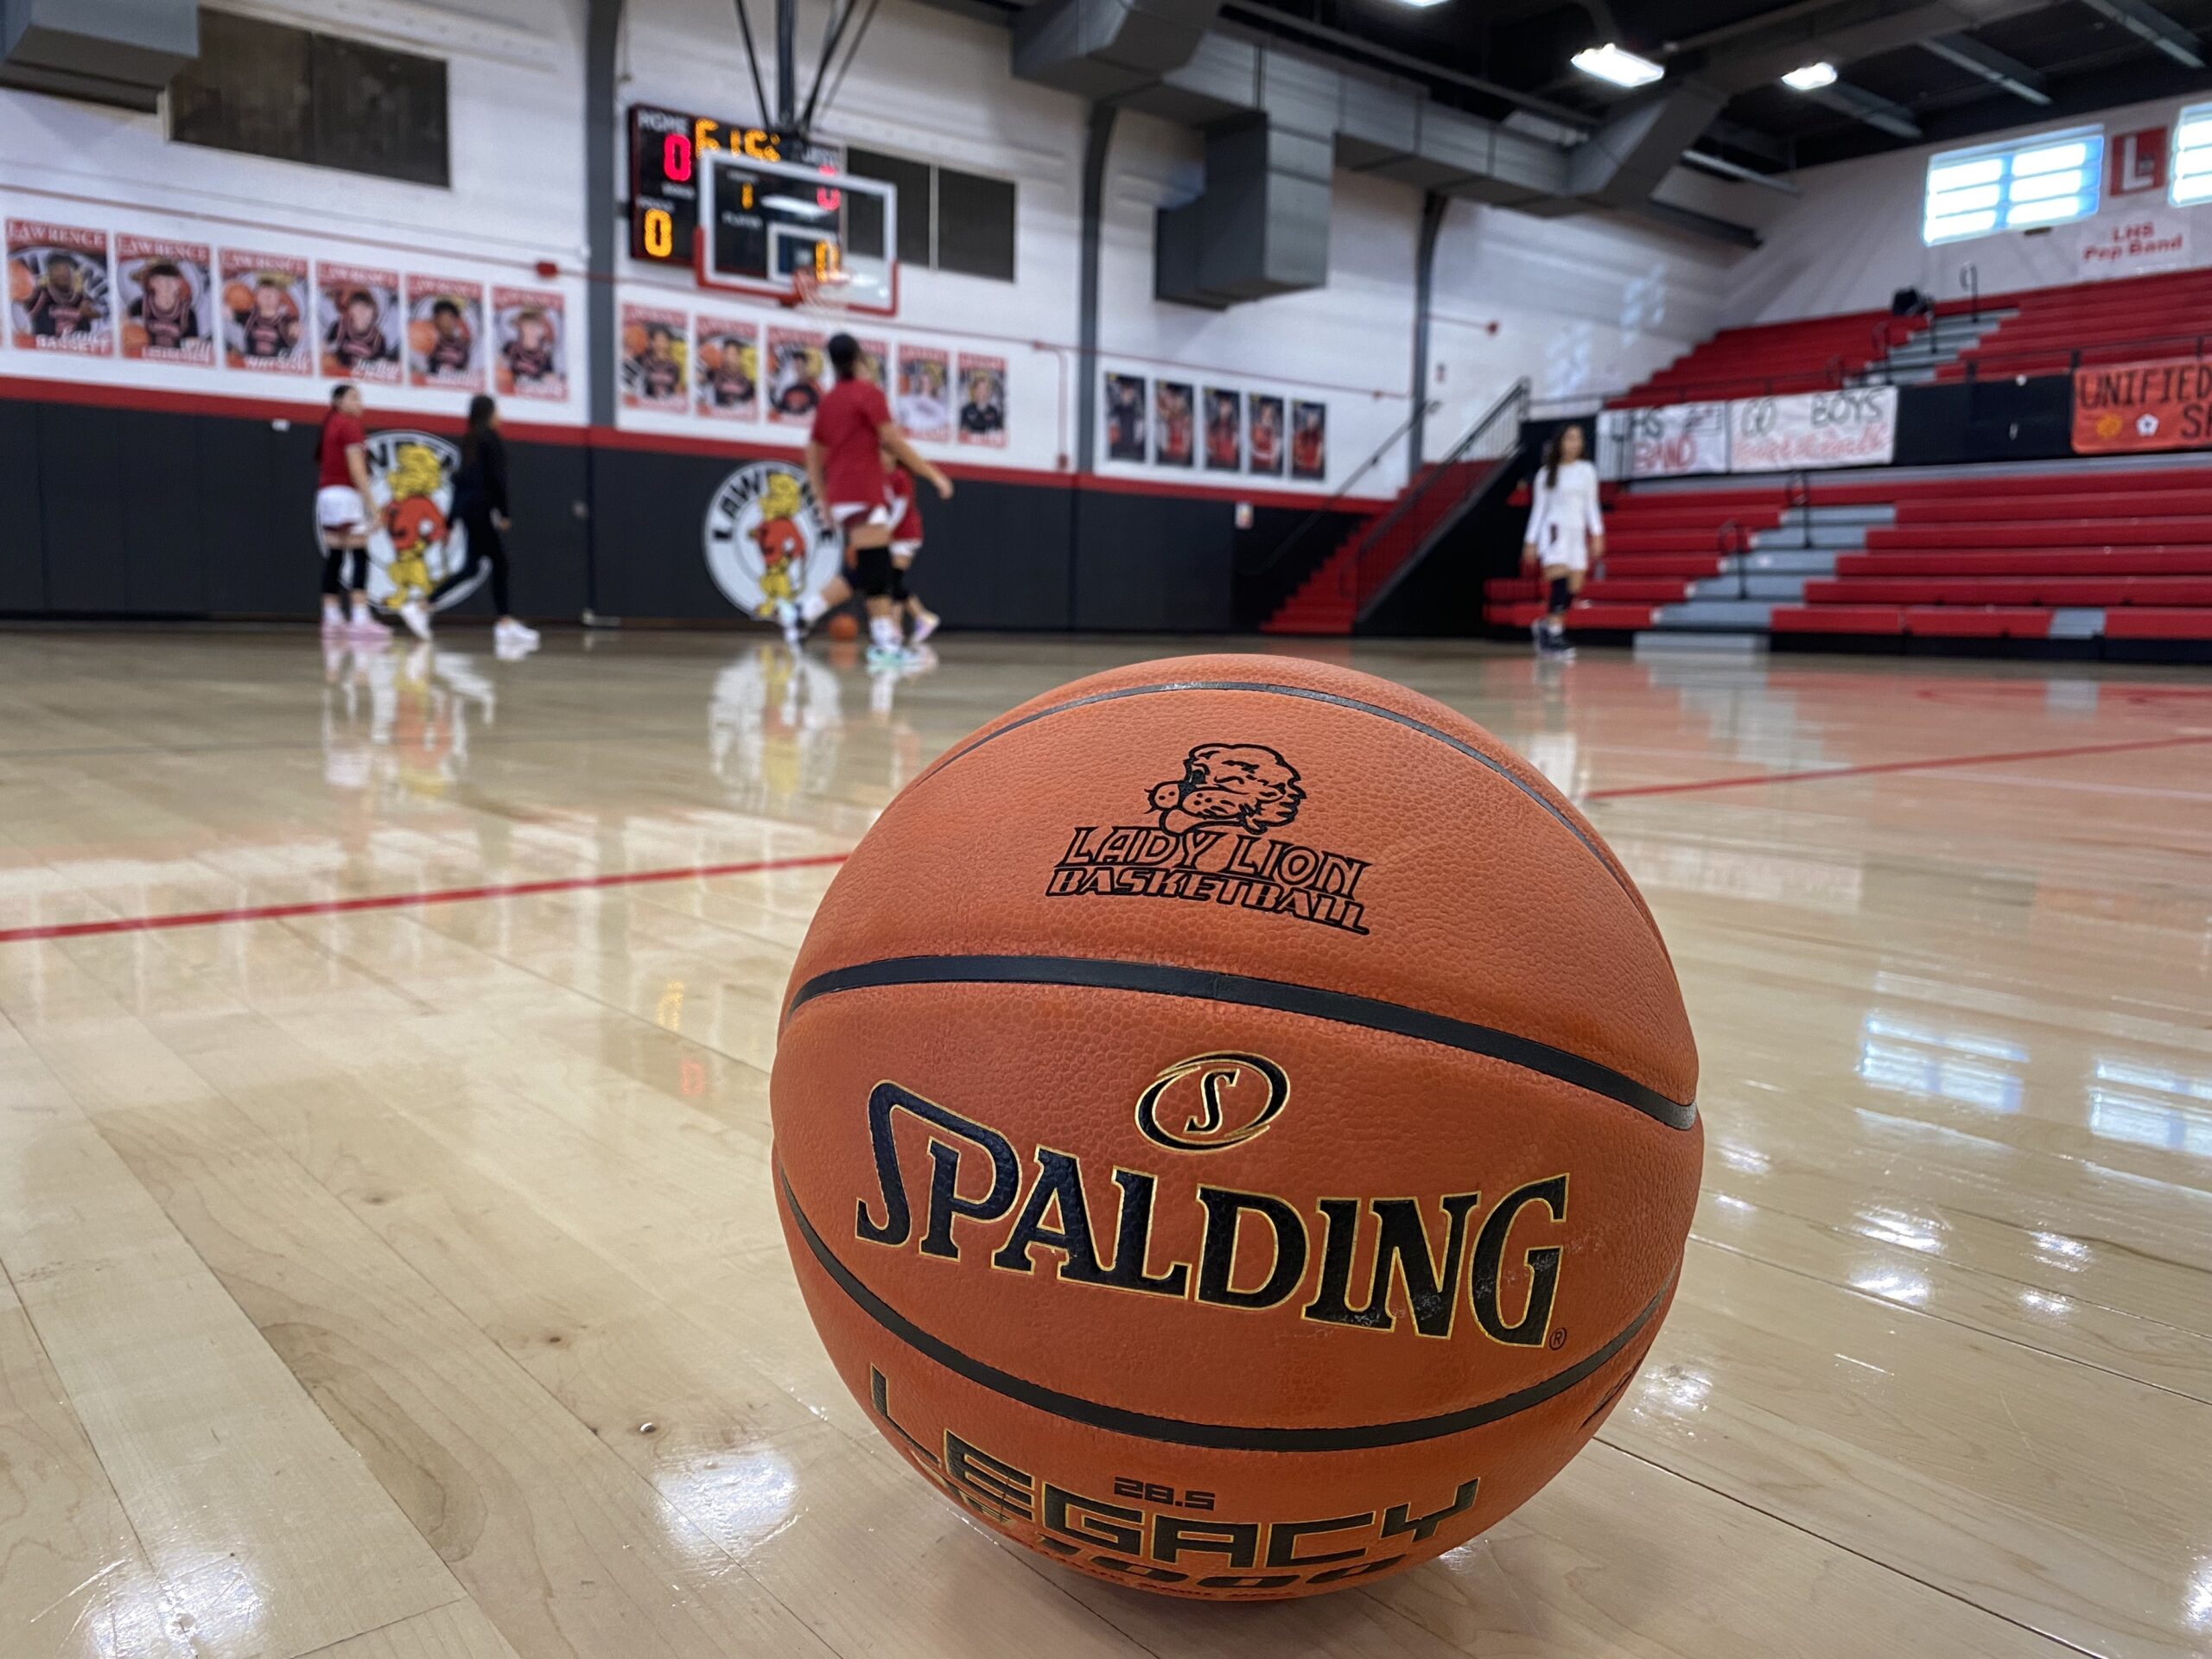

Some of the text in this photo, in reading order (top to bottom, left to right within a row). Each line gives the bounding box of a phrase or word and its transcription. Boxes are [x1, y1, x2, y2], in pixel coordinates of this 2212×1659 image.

[663, 133, 691, 181] 0
[643, 207, 672, 257] 0
[1054, 826, 1374, 900] LADY LION
[1046, 867, 1370, 936] BASKETBALL
[856, 1079, 1570, 1348] SPALDING
[870, 1363, 1479, 1569] LEGACY
[1113, 1476, 1216, 1511] 28.5
